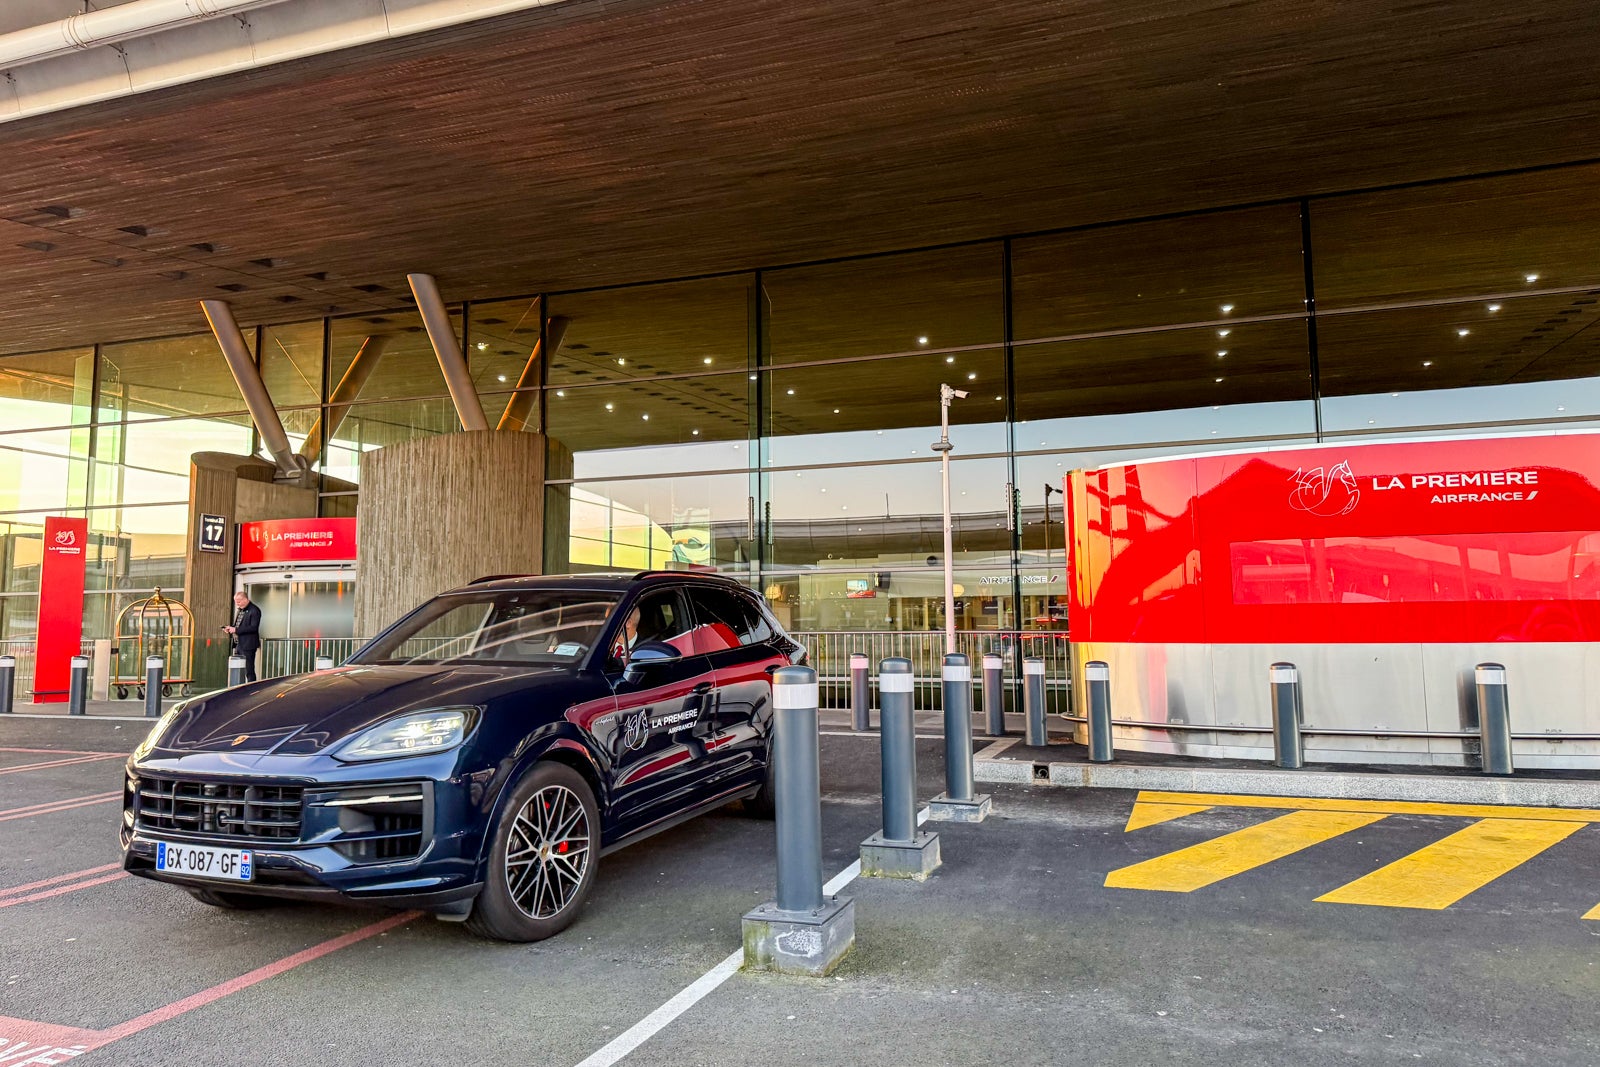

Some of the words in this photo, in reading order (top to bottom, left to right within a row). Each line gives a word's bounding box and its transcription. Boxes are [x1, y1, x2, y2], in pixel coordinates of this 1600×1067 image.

[1372, 475, 1406, 491] LA
[1411, 471, 1539, 489] PREMIERE
[1430, 491, 1524, 504] AIRFRANCE
[205, 525, 223, 541] 17
[271, 533, 283, 541] LA
[284, 531, 334, 540] PREMIERE
[979, 576, 1047, 584] AIRFRNCE
[651, 719, 663, 729] LA
[663, 708, 698, 725] PREMIERE
[667, 722, 694, 735] AIRFRANCE
[241, 866, 249, 876] 92
